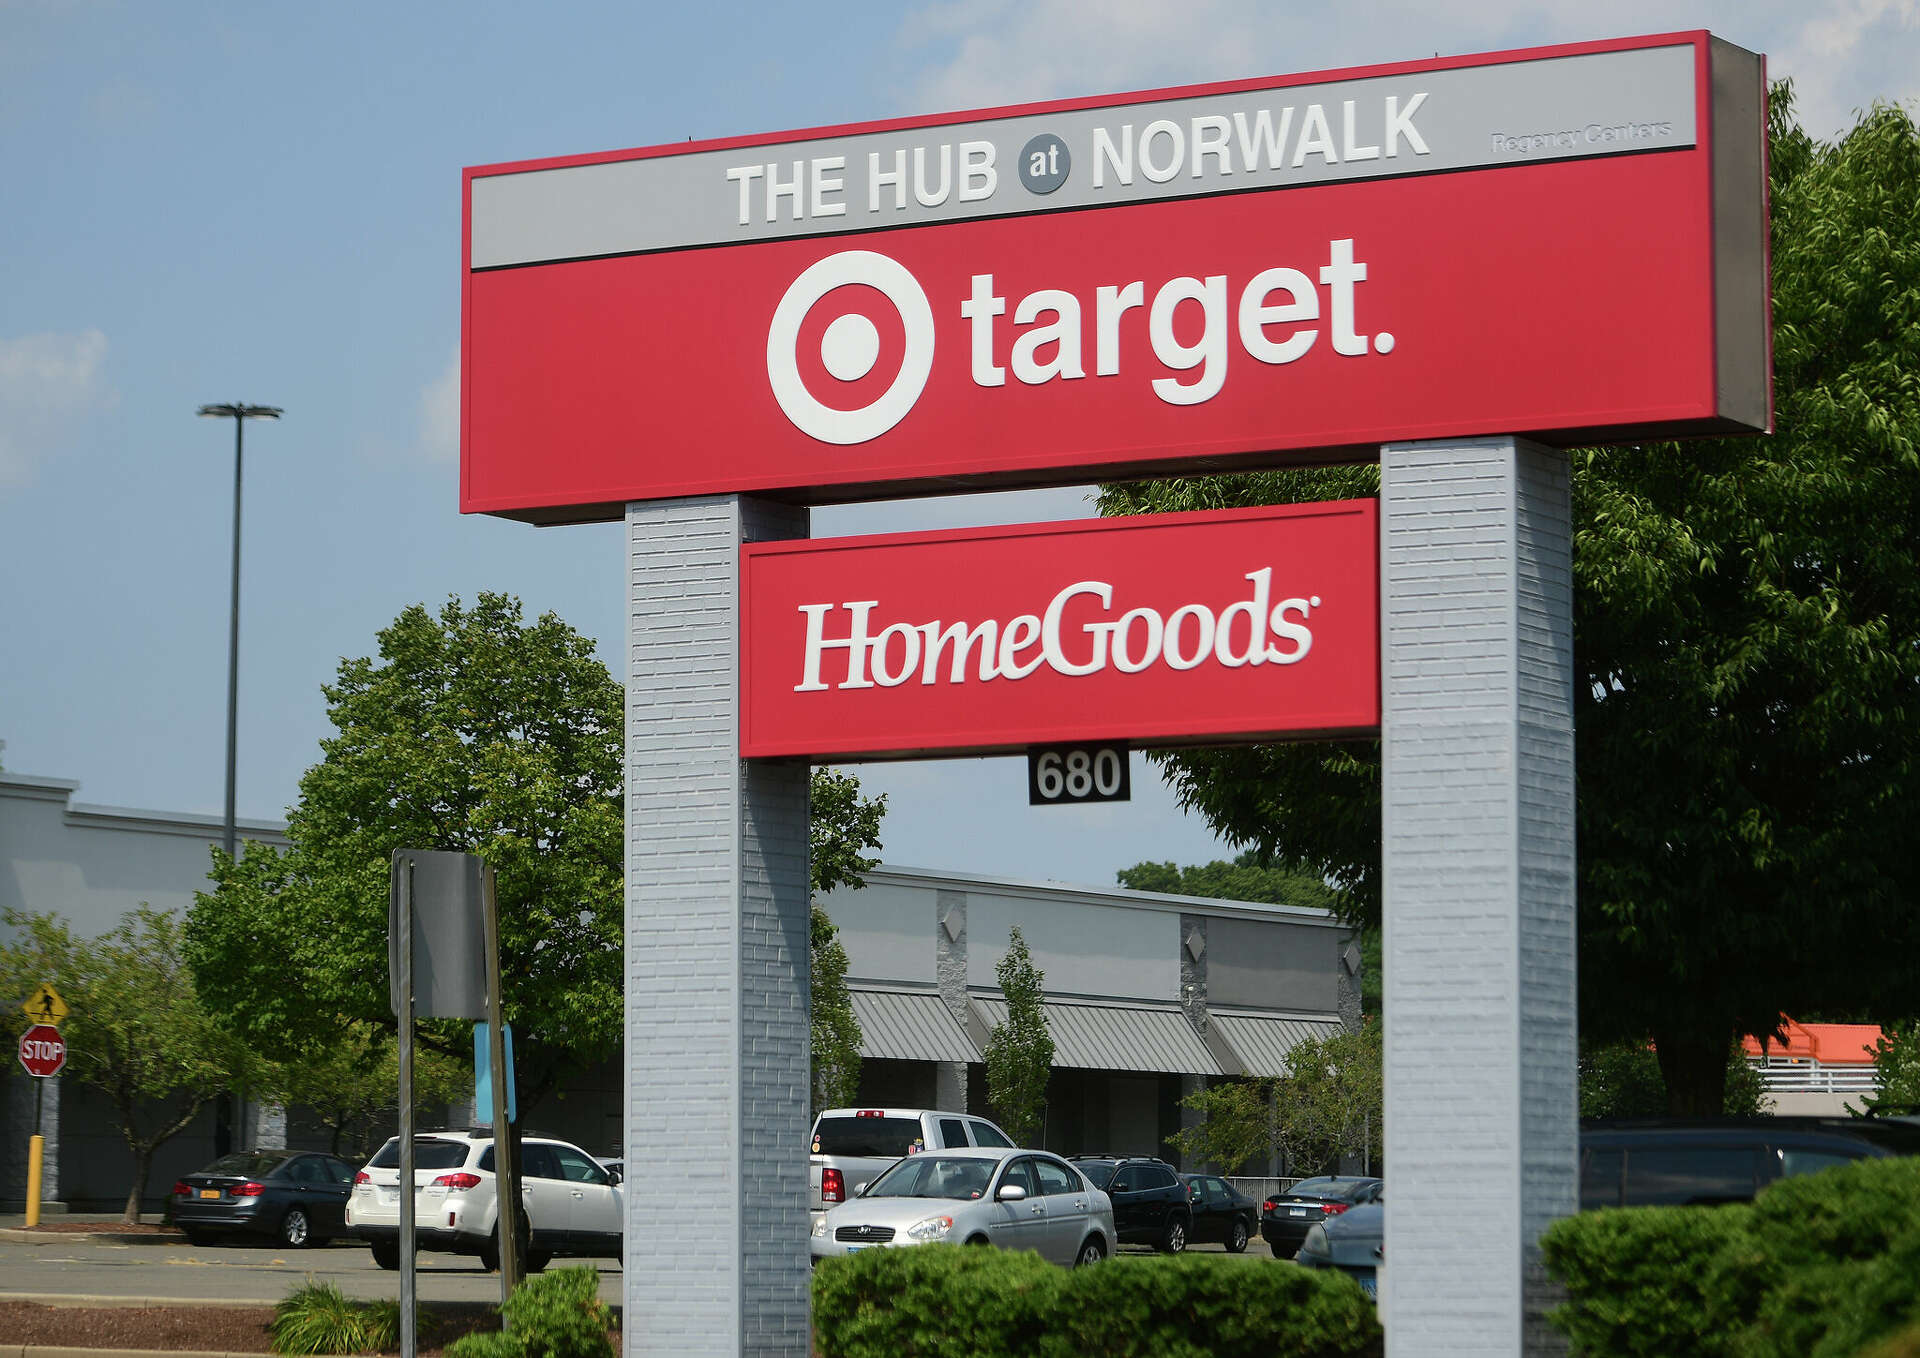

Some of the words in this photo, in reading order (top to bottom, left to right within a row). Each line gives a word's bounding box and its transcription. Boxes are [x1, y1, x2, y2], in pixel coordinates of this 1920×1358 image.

[726, 156, 847, 226] THE
[868, 140, 998, 213] HUB
[1029, 143, 1059, 178] at
[1092, 92, 1432, 189] NORWALK
[1491, 130, 1581, 153] Regency
[1584, 121, 1673, 144] Centers
[961, 238, 1396, 406] target.
[793, 566, 1315, 692] HomeGoods
[1036, 748, 1121, 799] 680
[23, 1040, 64, 1060] STOP
